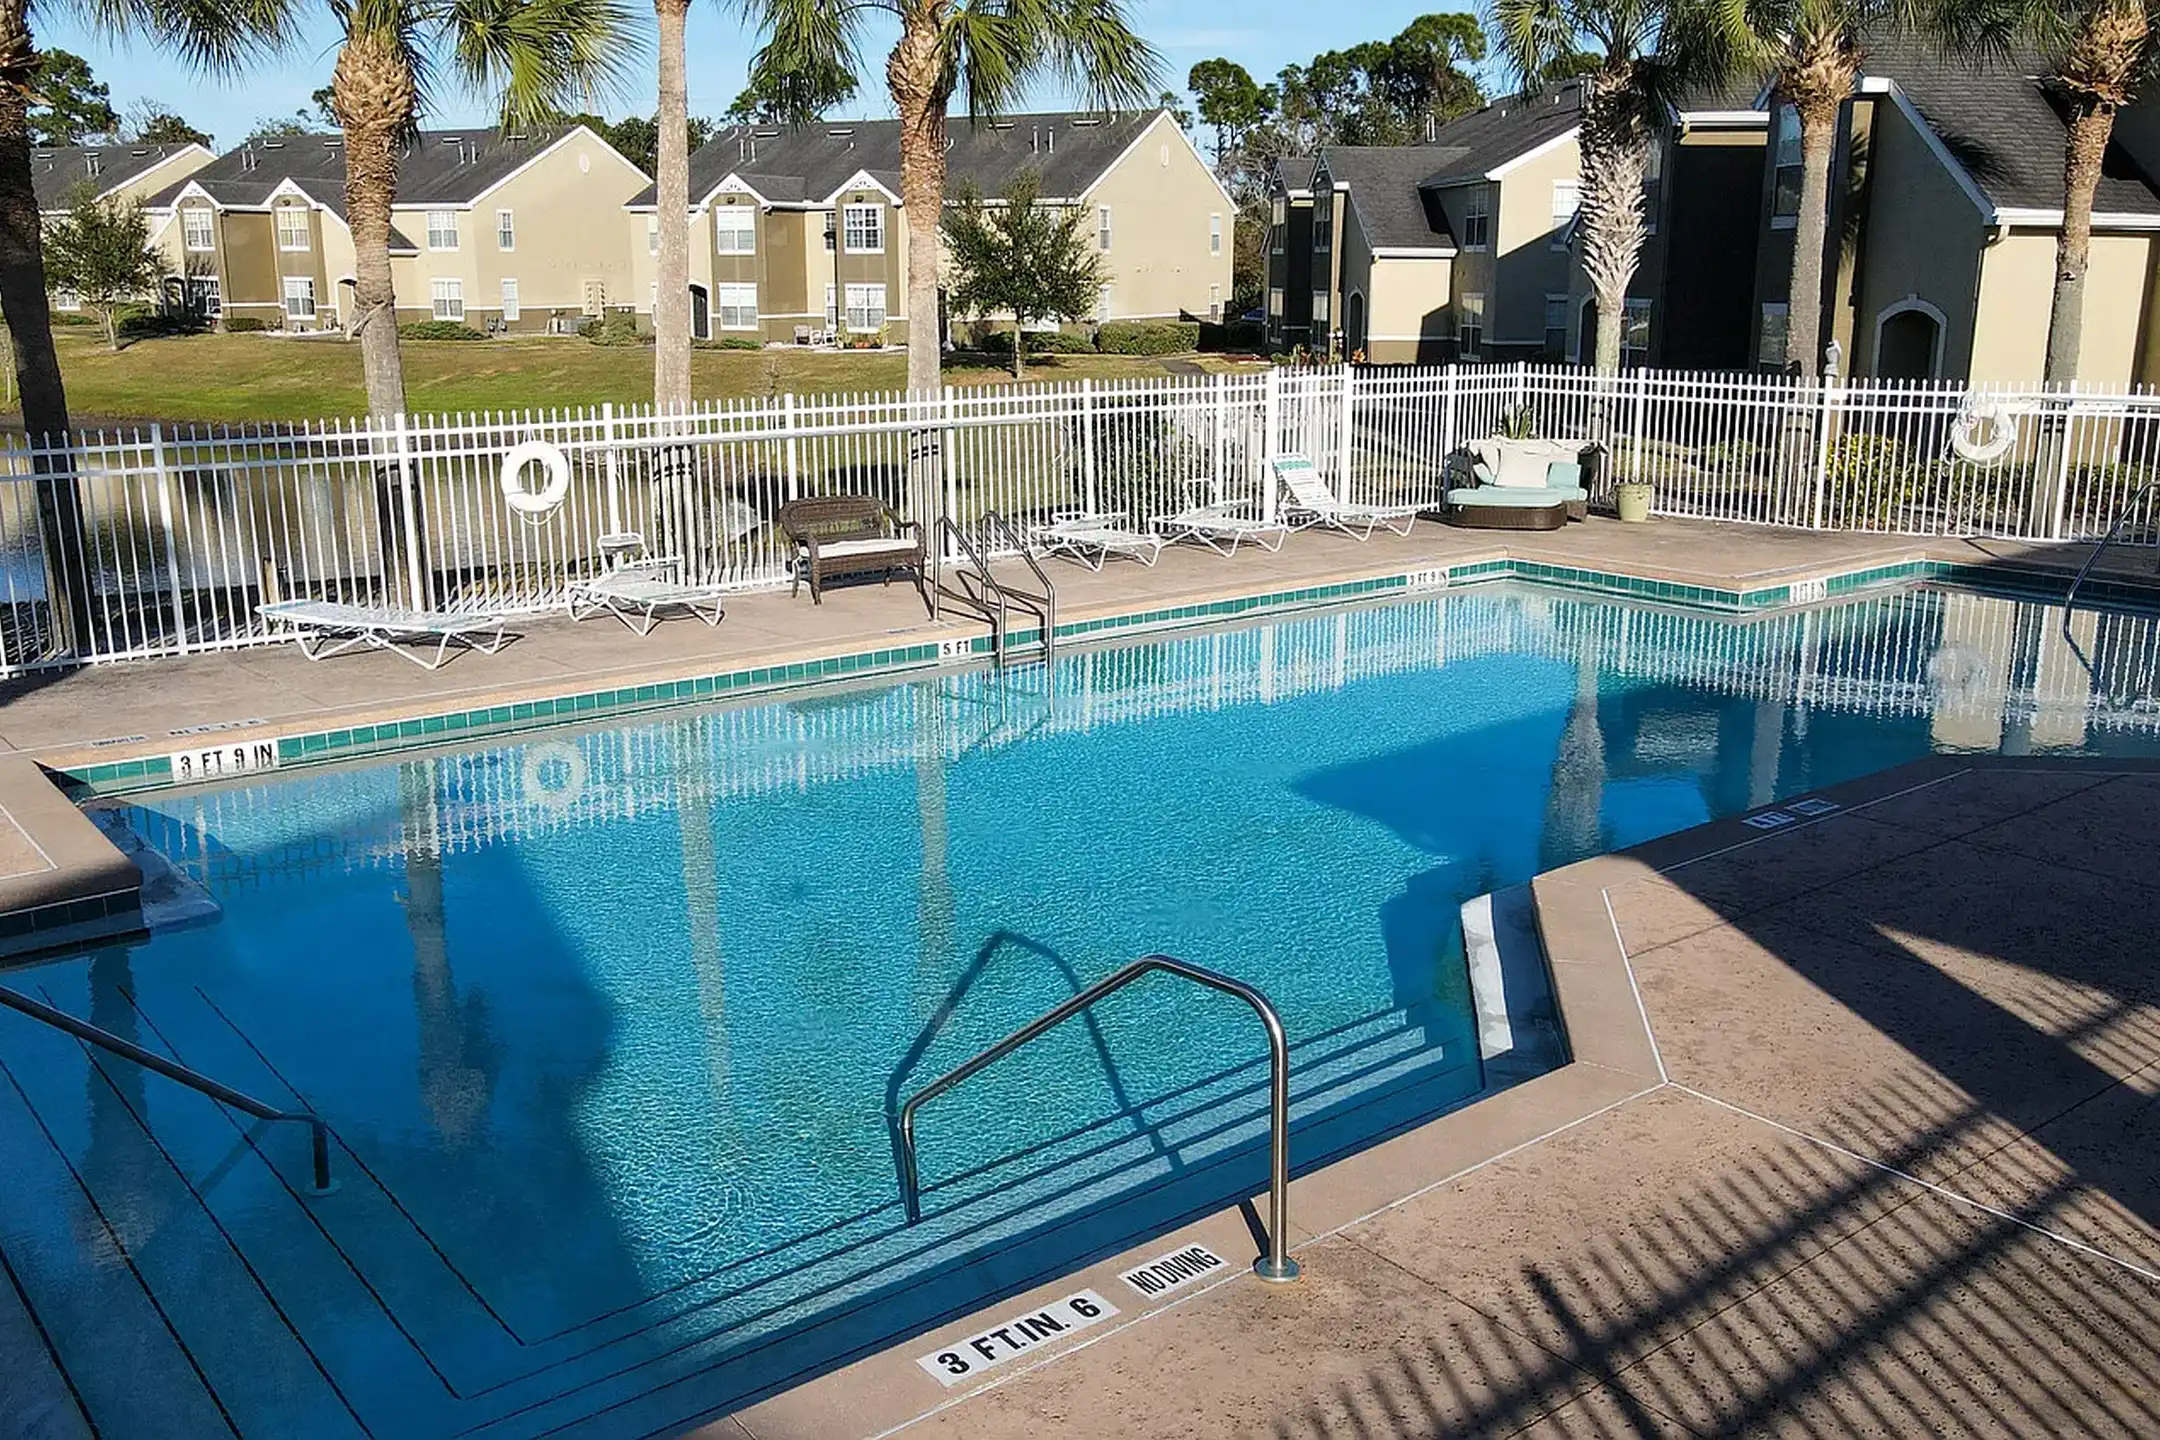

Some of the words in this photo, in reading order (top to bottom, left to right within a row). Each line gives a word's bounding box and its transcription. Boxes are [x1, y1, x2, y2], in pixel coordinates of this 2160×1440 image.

[943, 642, 952, 656] 5
[956, 640, 970, 654] FT
[180, 755, 192, 778] 3
[201, 750, 223, 776] FT
[233, 747, 246, 770] 9
[253, 743, 274, 769] IN
[1126, 1270, 1167, 1295] NO
[1149, 1247, 1223, 1285] DIVING
[937, 1352, 971, 1375] 3
[1068, 1297, 1101, 1318] 6
